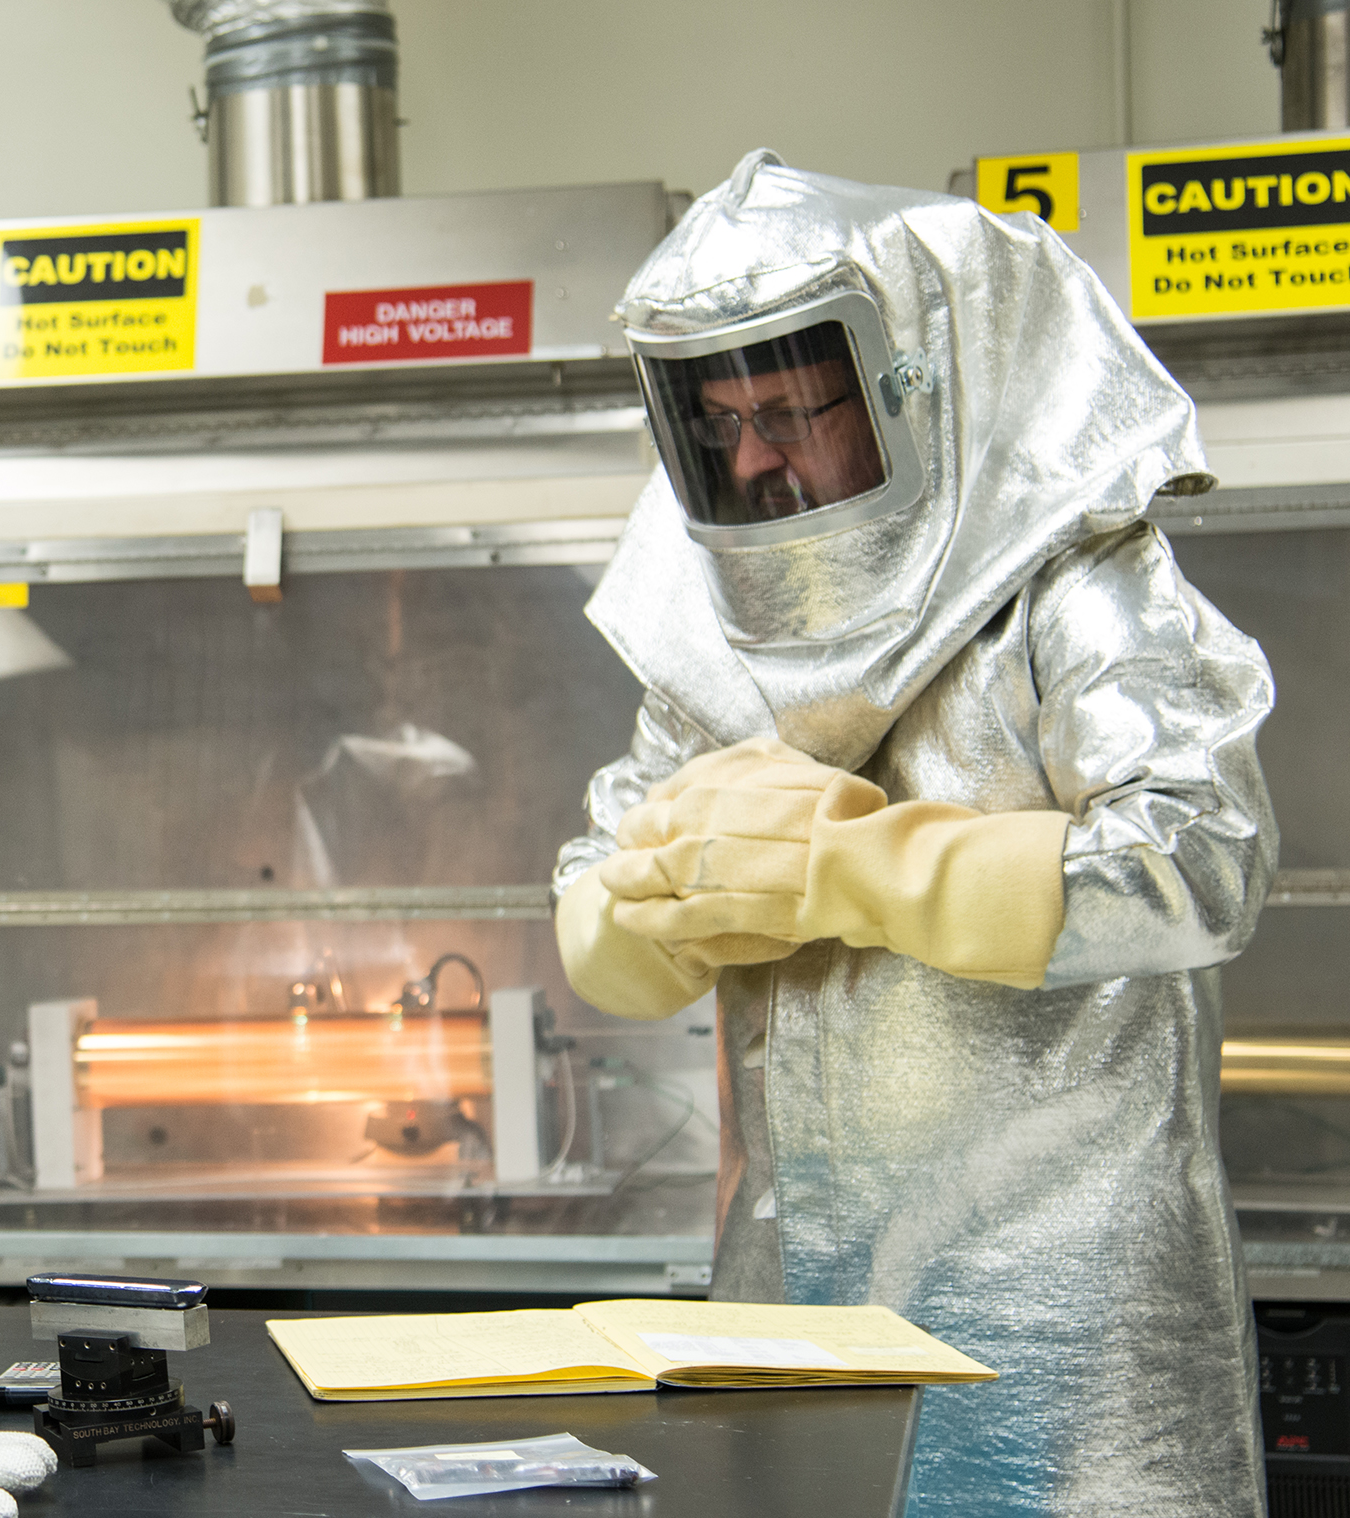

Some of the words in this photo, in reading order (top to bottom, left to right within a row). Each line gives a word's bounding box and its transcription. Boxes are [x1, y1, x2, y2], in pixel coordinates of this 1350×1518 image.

[1005, 165, 1055, 221] 5
[1144, 169, 1350, 216] CAUTION
[1166, 247, 1218, 264] Hot
[1231, 240, 1349, 260] Surface
[2, 247, 187, 287] CAUTION
[1154, 276, 1192, 295] Do
[1204, 271, 1256, 291] Not
[1269, 265, 1350, 286] Touc
[16, 314, 58, 331] Hot
[70, 310, 168, 330] Surface
[375, 297, 477, 325] DANGER
[338, 323, 399, 347] HIGH
[406, 316, 514, 344] VOLTAGE
[3, 343, 35, 360] Do
[44, 340, 88, 358] Not
[98, 335, 178, 355] Touch
[73, 1428, 102, 1439] SOUTH
[103, 1425, 120, 1436] BAY
[183, 1414, 200, 1424] INC.
